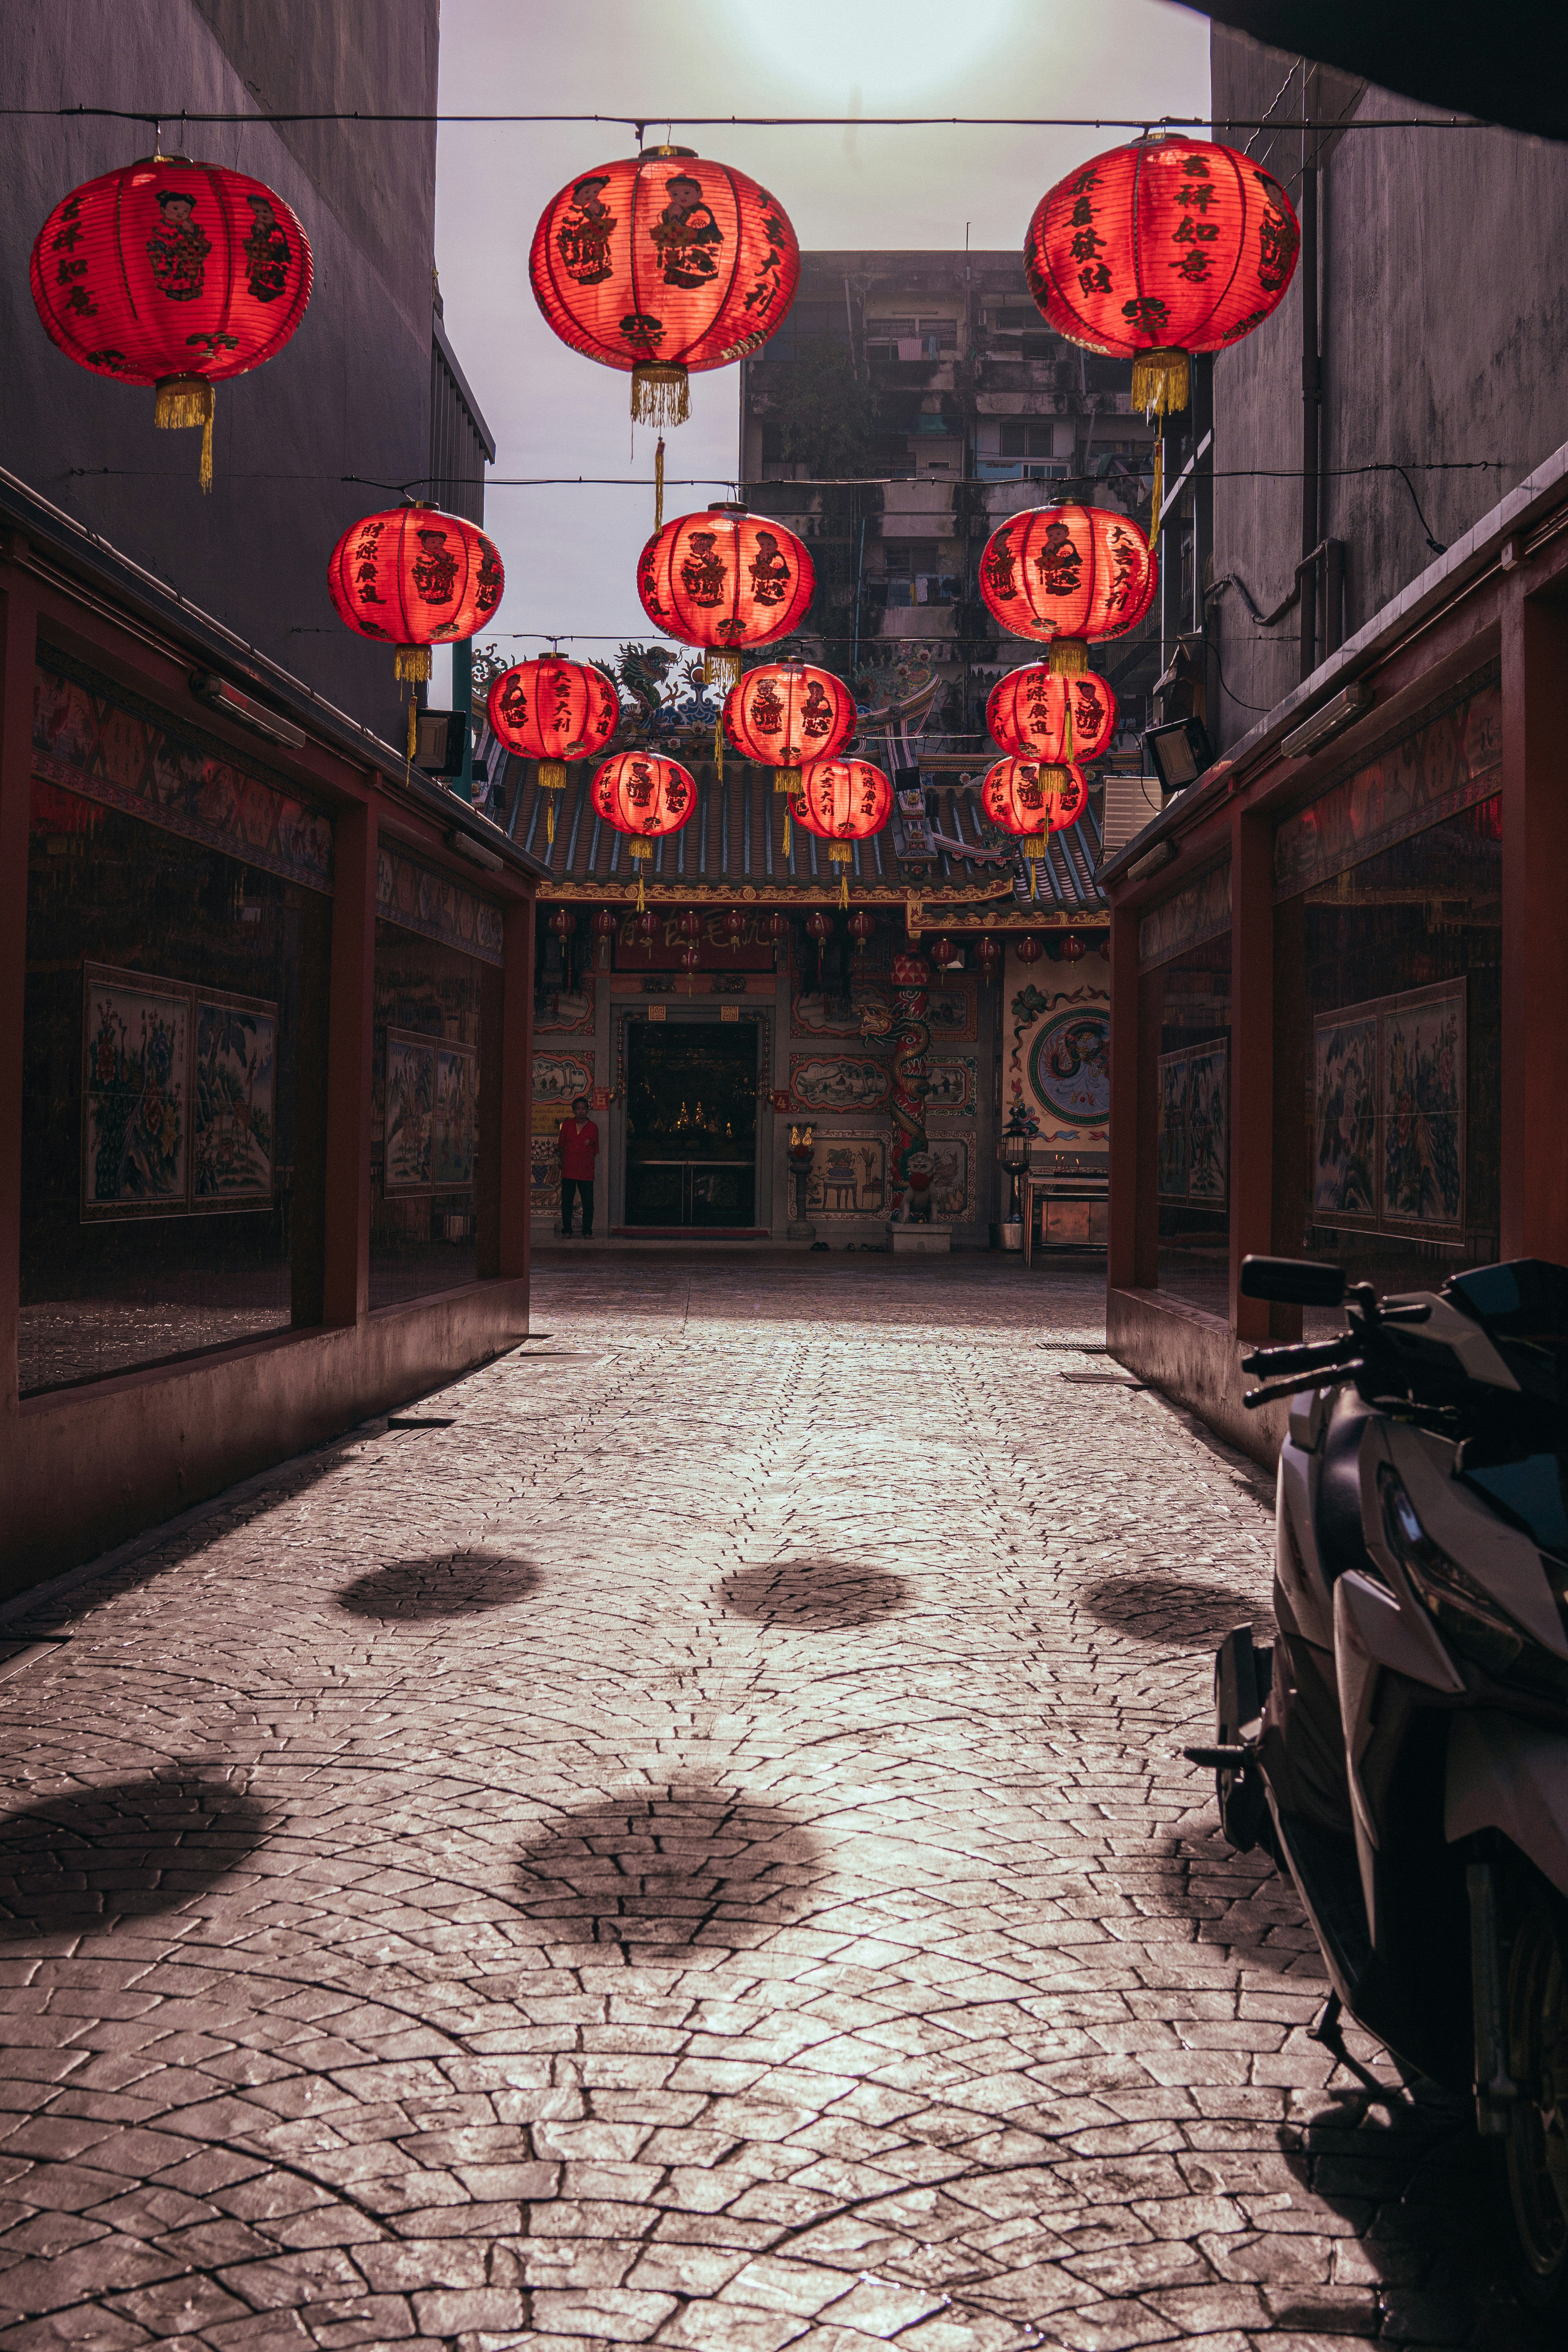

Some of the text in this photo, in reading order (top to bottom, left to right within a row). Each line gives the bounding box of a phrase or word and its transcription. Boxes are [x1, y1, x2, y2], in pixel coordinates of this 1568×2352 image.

[1062, 167, 1114, 299] 恭喜發財
[1168, 155, 1220, 283] 吉祥如意
[52, 196, 99, 317] 吉祥如意
[744, 188, 786, 318] 大吉大利
[1104, 526, 1134, 612] 大吉大利
[552, 670, 572, 733] 大吉大利
[991, 680, 1008, 739] 大吉大利
[1026, 673, 1054, 735] 財源廣進
[599, 763, 615, 814] 吉祥如意
[819, 767, 835, 817] 大吉大利
[860, 766, 877, 817] 財源廣進
[990, 766, 1008, 816] 吉祥如意
[596, 1094, 606, 1105] 5
[777, 1096, 787, 1109] 4
